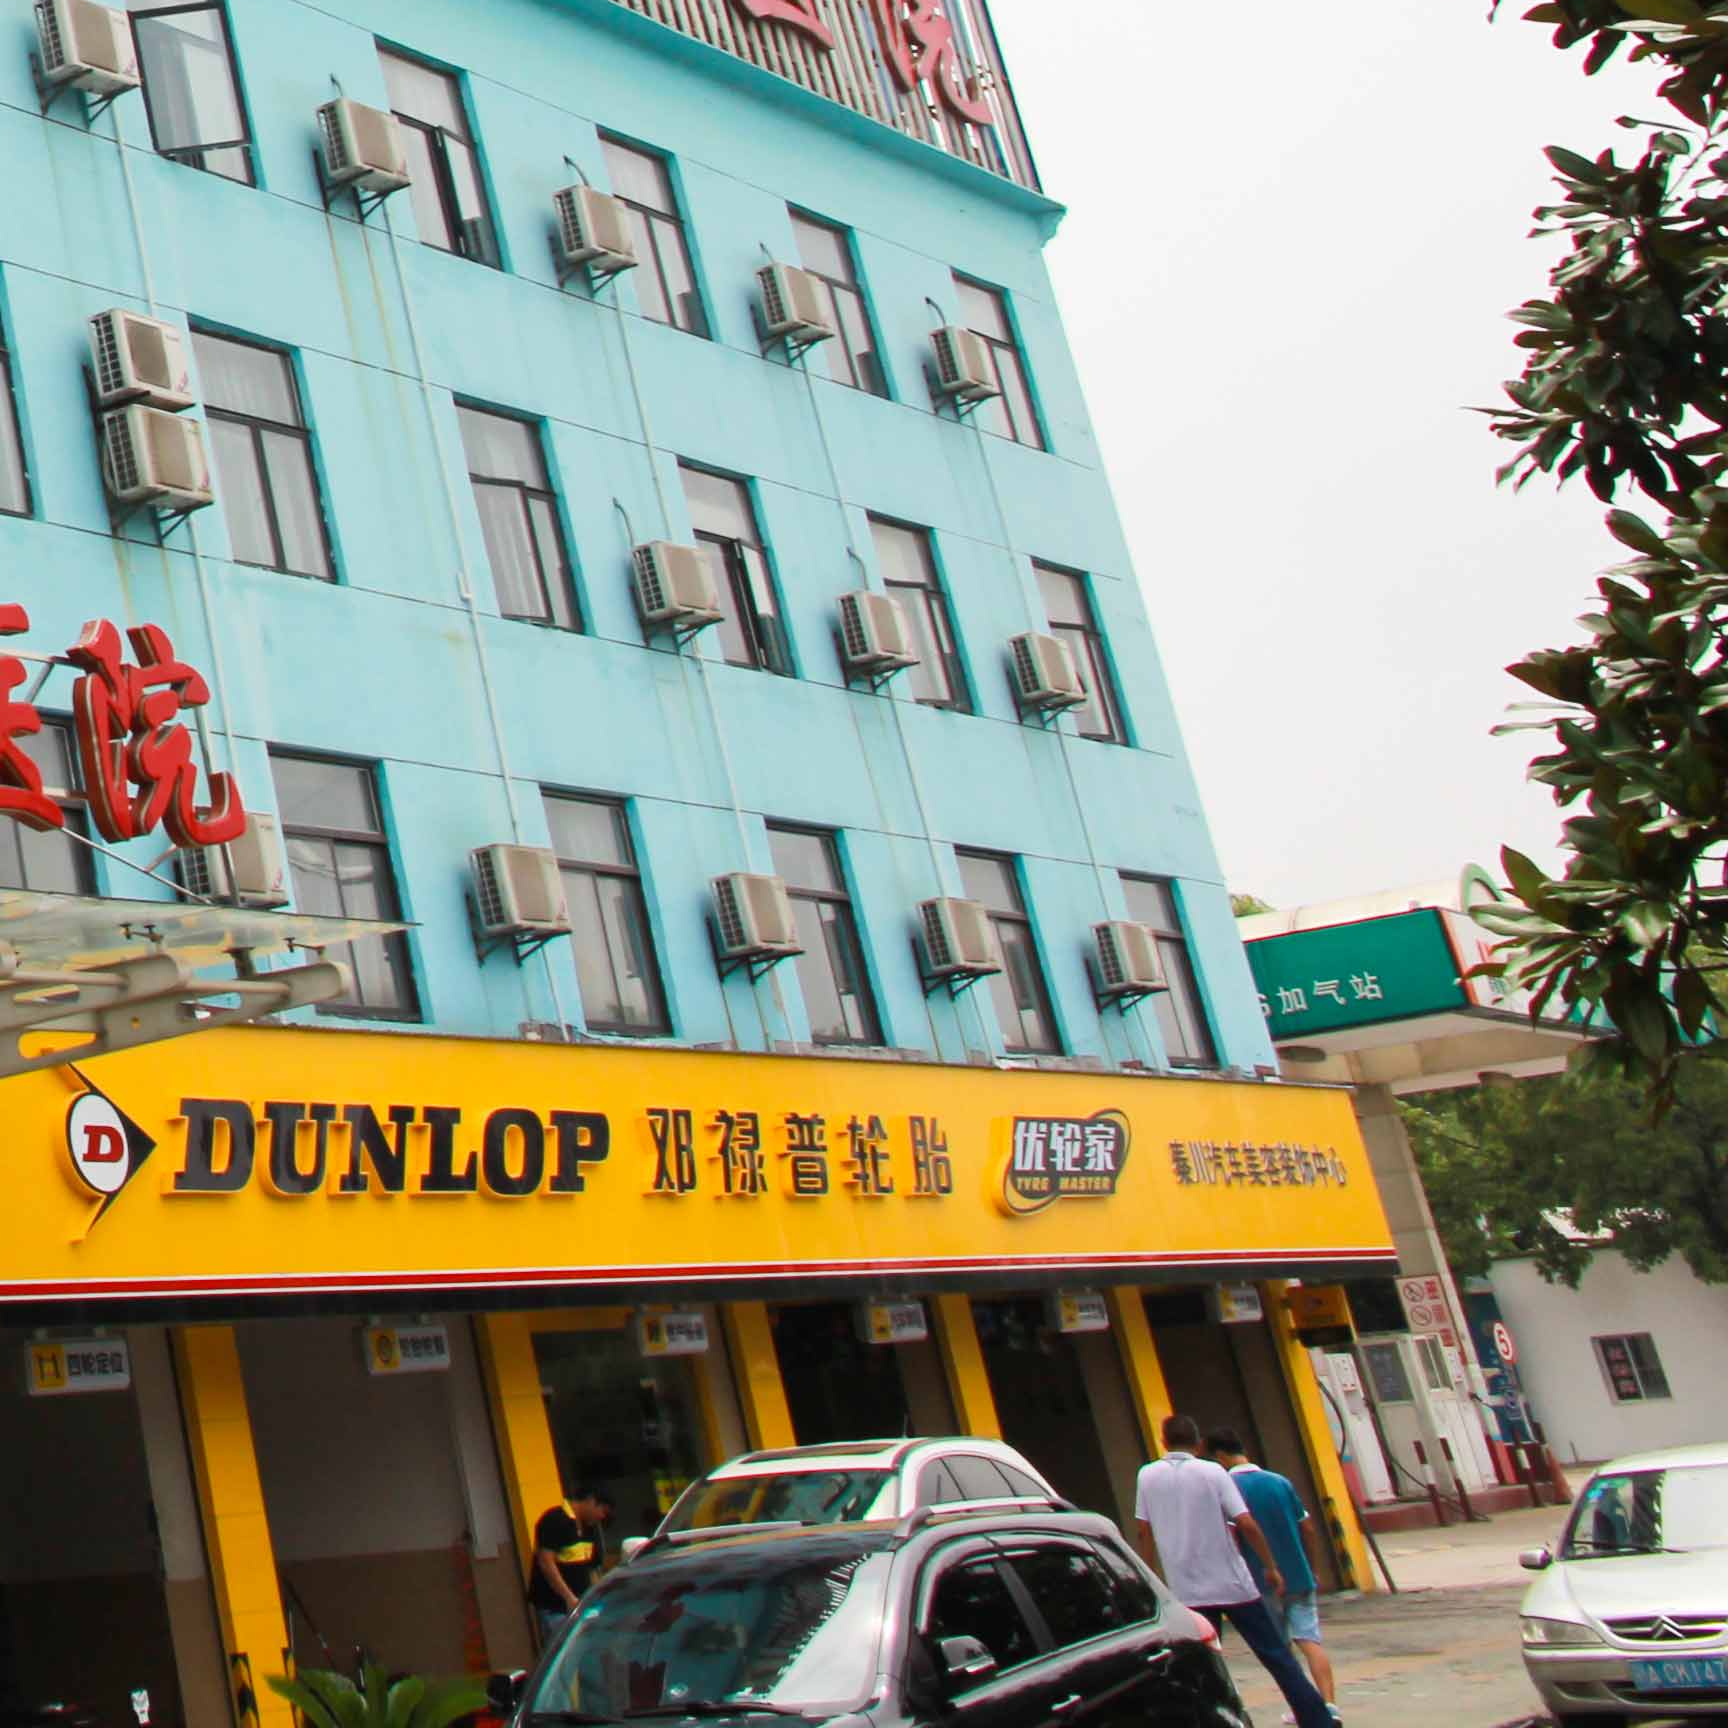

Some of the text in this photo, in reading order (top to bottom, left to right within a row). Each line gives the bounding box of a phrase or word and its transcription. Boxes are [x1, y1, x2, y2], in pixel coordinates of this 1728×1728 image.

[83, 1124, 125, 1163] D
[172, 1097, 611, 1196] DUNLOP
[645, 1108, 953, 1197] 邓禄普轮胎
[1014, 1120, 1117, 1172] 优轮家
[1017, 1175, 1111, 1192] TYRE MASTER
